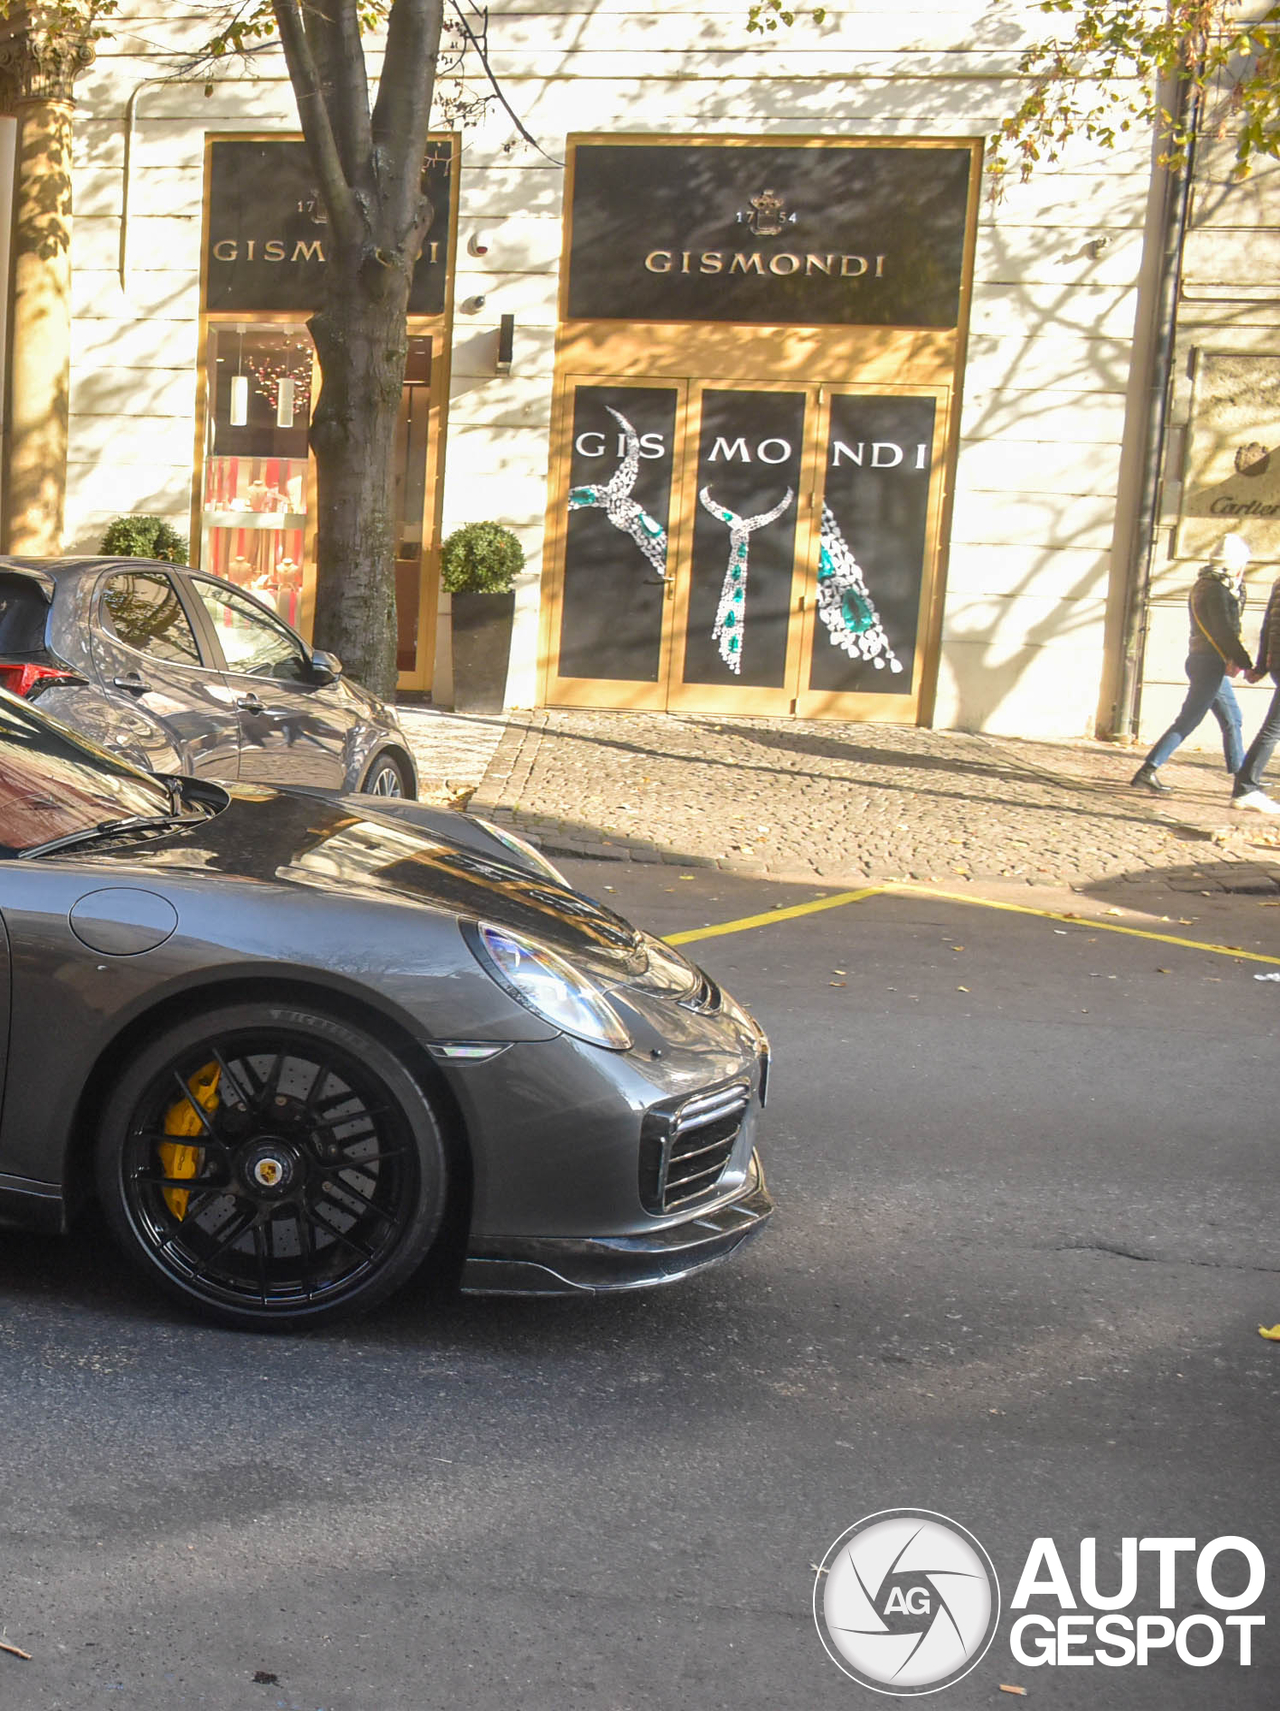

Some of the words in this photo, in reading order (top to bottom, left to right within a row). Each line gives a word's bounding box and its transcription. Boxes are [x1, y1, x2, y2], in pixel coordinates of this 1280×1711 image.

[644, 251, 885, 278] GISMONDI
[574, 432, 665, 459] GIS
[707, 437, 792, 464] MO
[831, 441, 927, 469] NDI
[1210, 496, 1280, 516] Cartier
